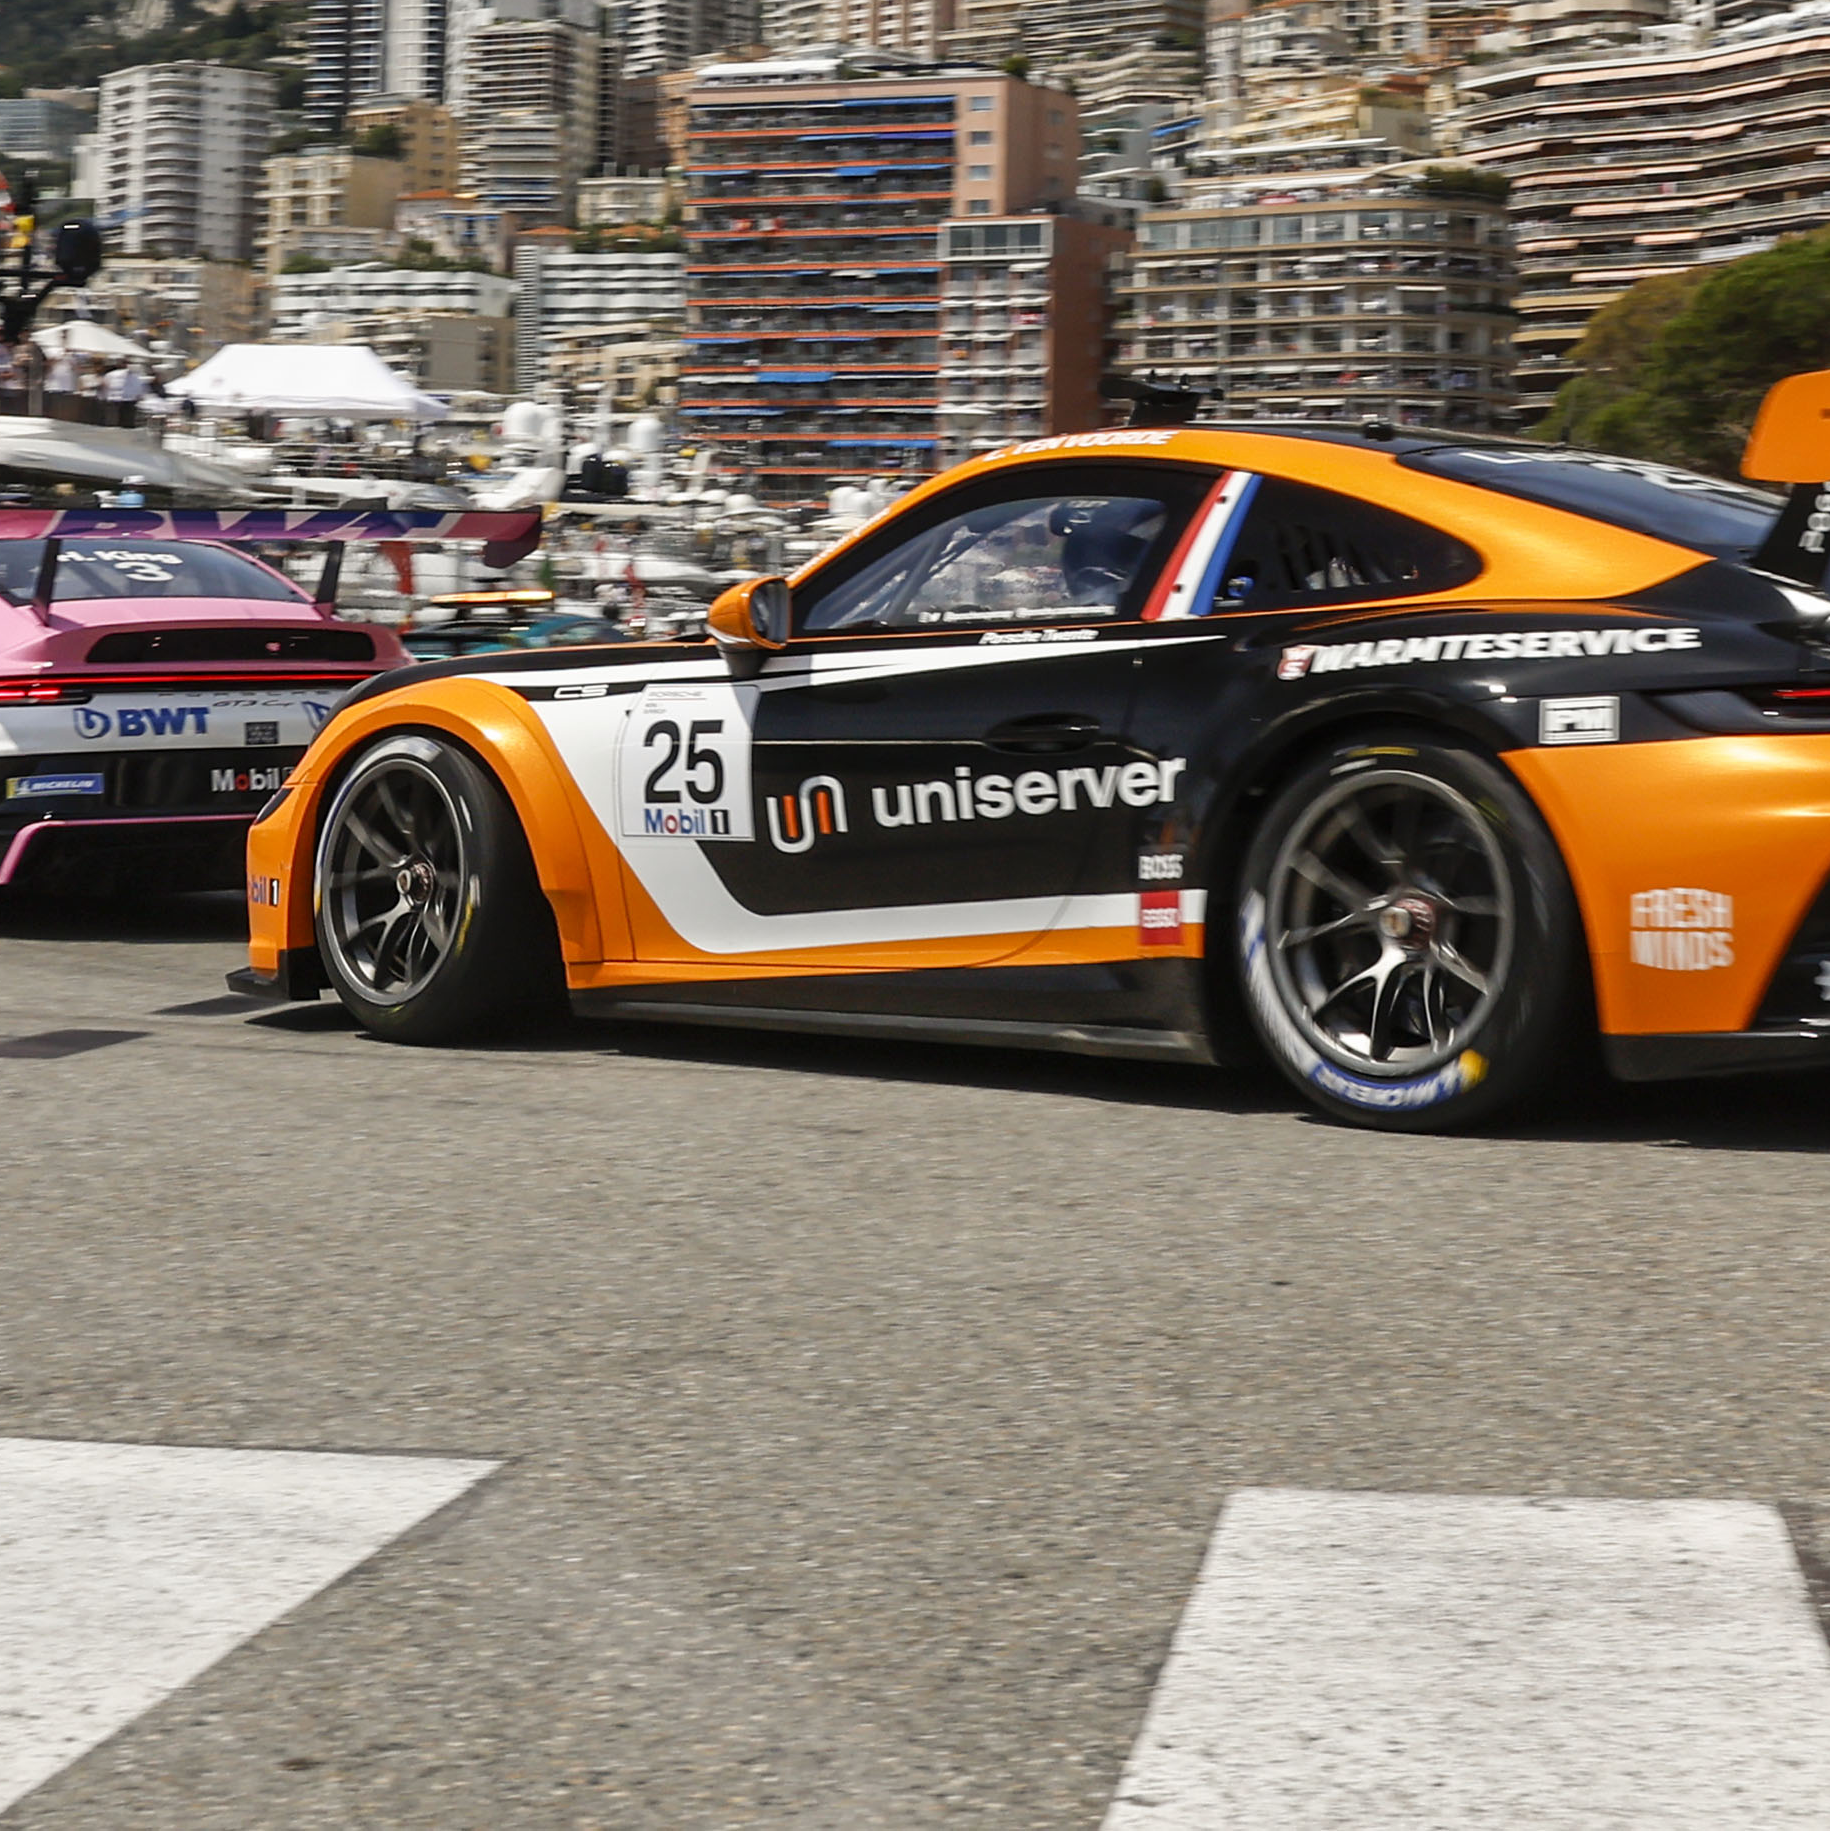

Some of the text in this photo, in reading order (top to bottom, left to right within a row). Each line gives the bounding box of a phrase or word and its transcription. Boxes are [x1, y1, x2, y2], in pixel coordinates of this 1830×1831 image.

[93, 550, 184, 564] King
[114, 561, 174, 581] 3
[1310, 627, 1703, 674] WARMTESERVICE
[116, 706, 211, 737] BWT
[643, 719, 724, 804] 25
[211, 768, 280, 791] Mobil
[872, 757, 1187, 828] uniserver
[644, 809, 728, 834] Mobil 1
[1631, 887, 1733, 928] FRESH
